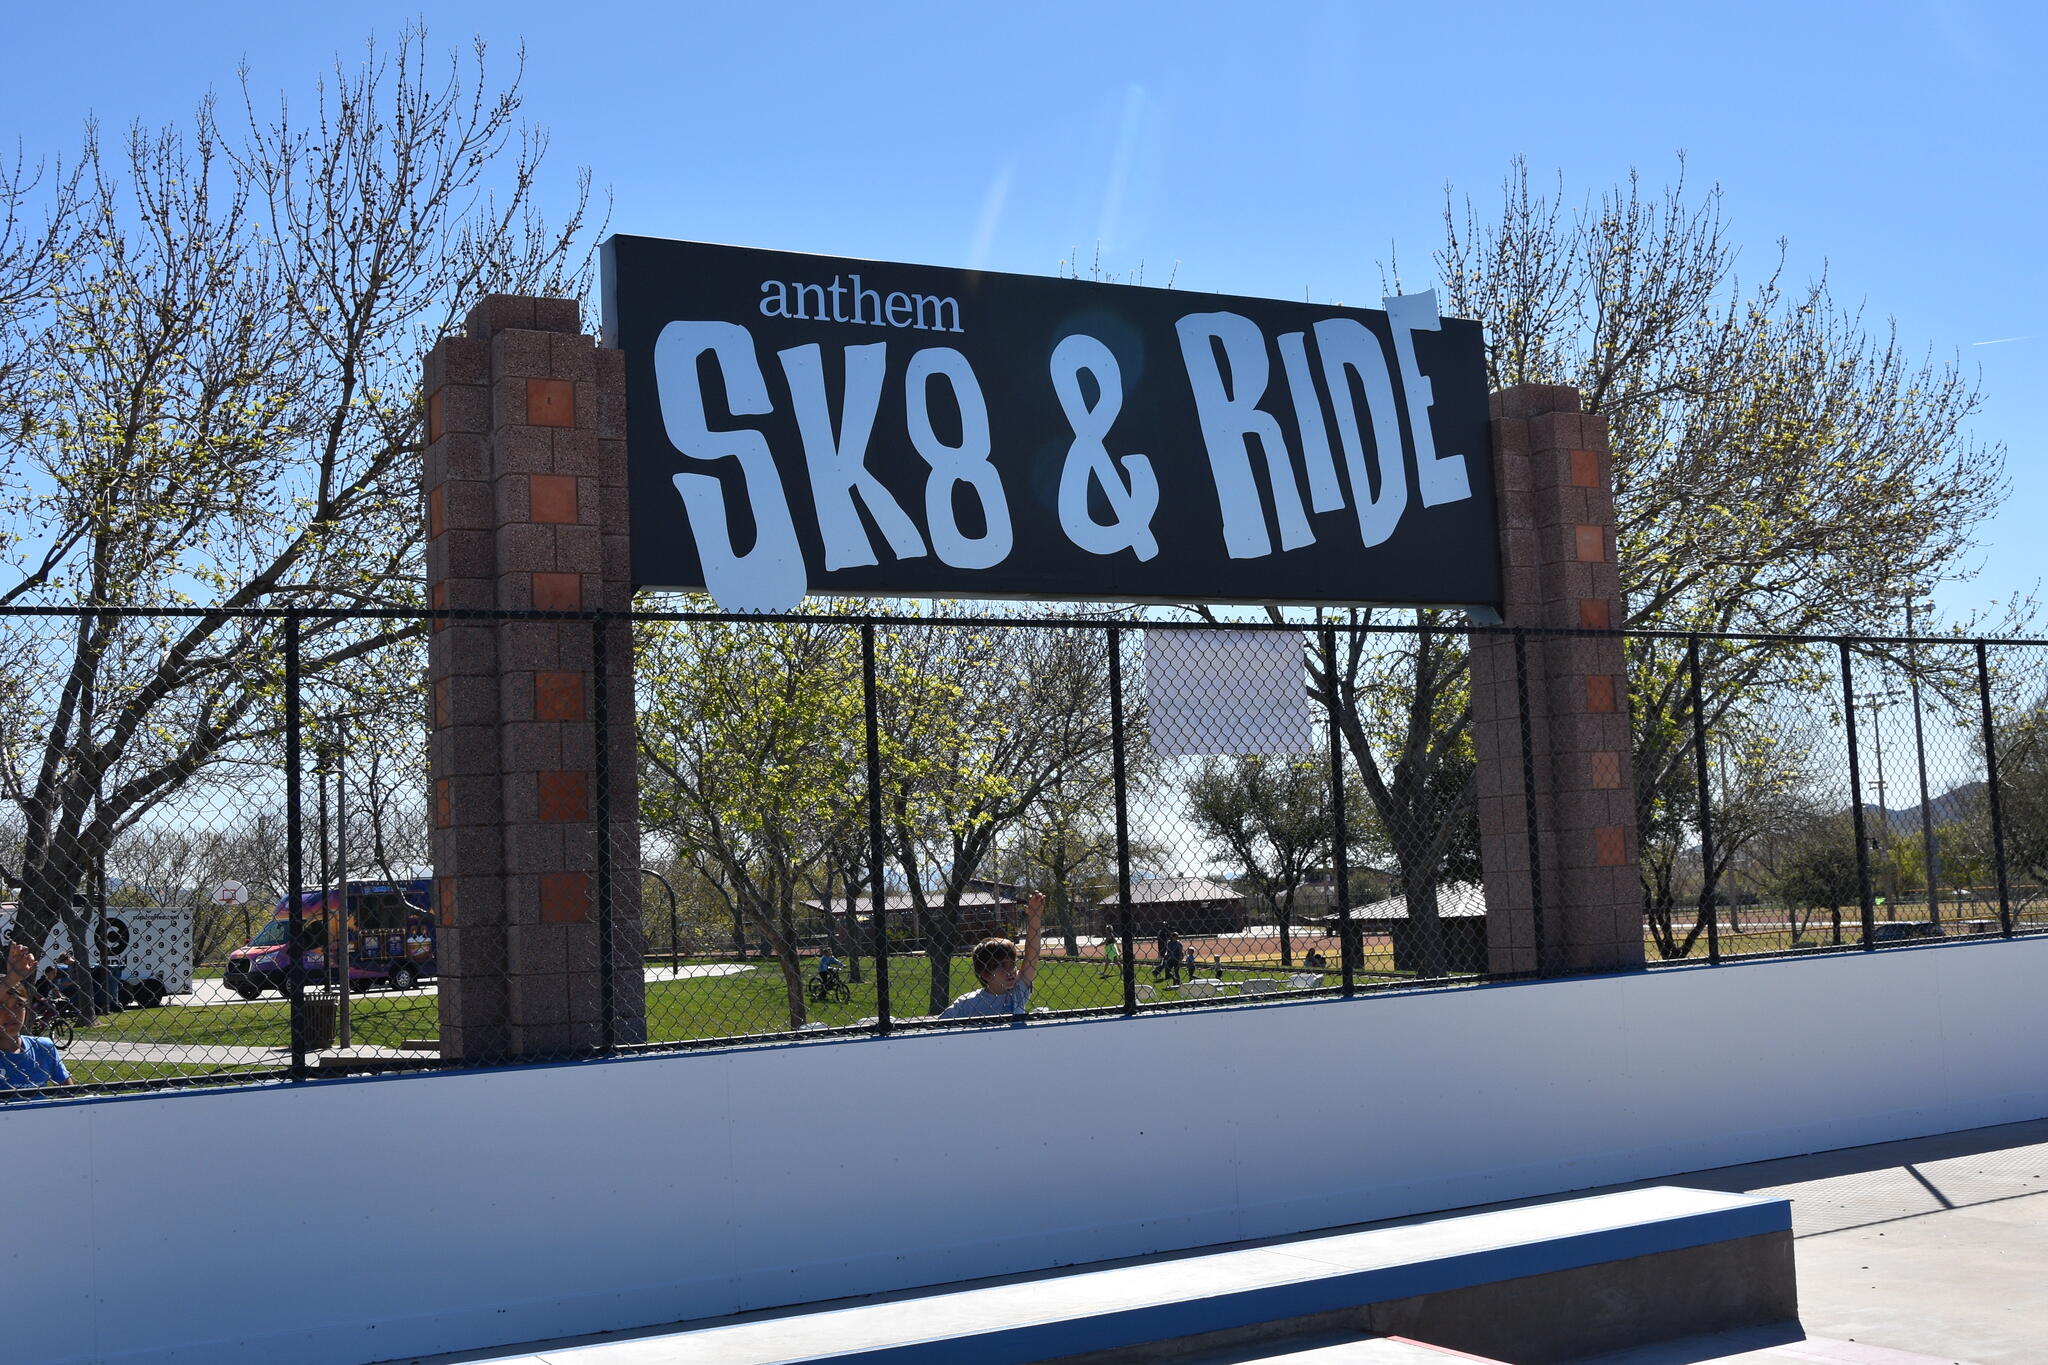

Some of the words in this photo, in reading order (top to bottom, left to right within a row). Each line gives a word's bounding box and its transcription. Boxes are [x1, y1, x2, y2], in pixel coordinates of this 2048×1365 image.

[759, 274, 965, 333] anthem
[654, 320, 1014, 611] SK8
[1050, 334, 1159, 562] &
[1175, 289, 1471, 559] RIDE
